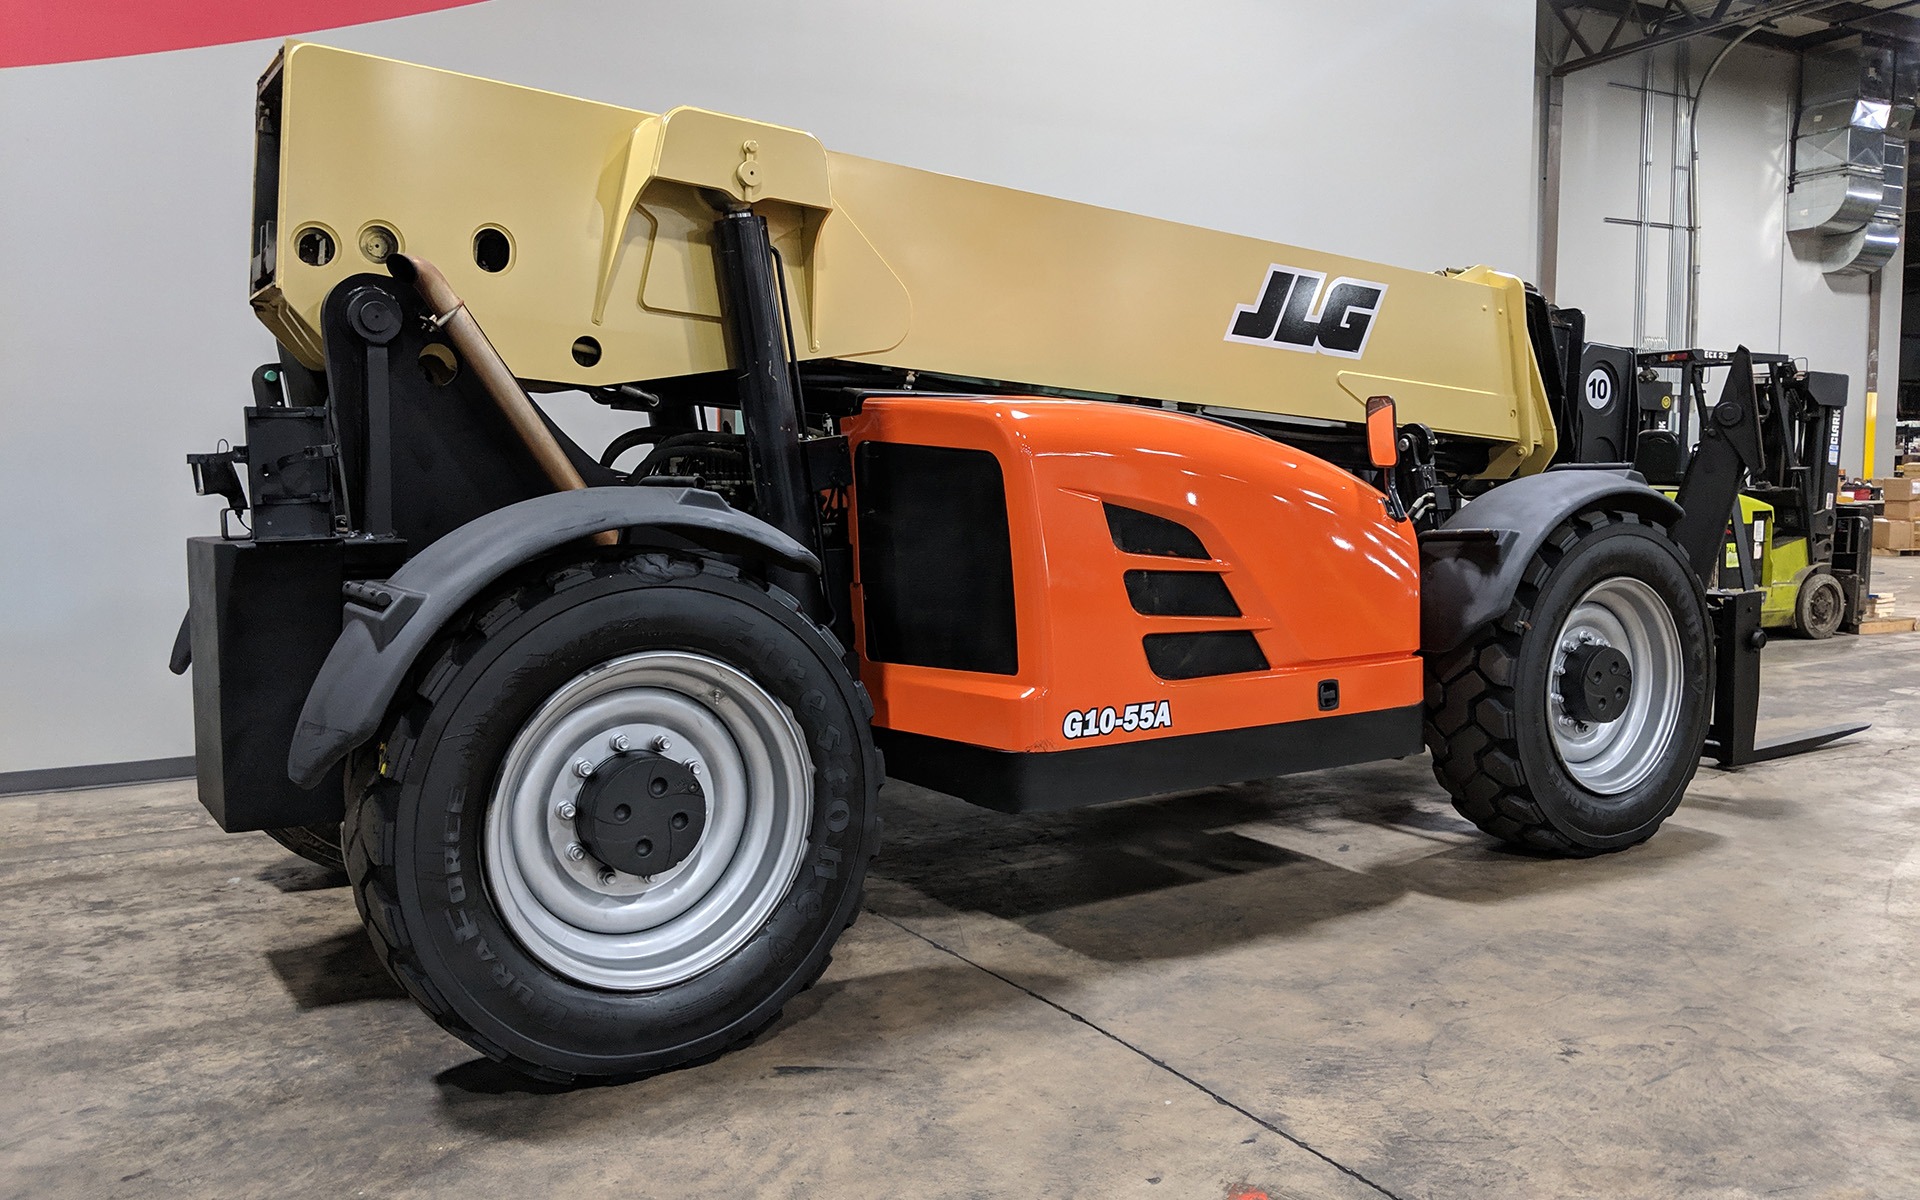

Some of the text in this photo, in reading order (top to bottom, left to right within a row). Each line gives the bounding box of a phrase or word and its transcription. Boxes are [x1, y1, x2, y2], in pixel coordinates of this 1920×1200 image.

[1230, 269, 1383, 354] JLG
[1588, 378, 1608, 400] 10
[1830, 409, 1841, 445] CLARK
[1063, 700, 1172, 739] G10-55A
